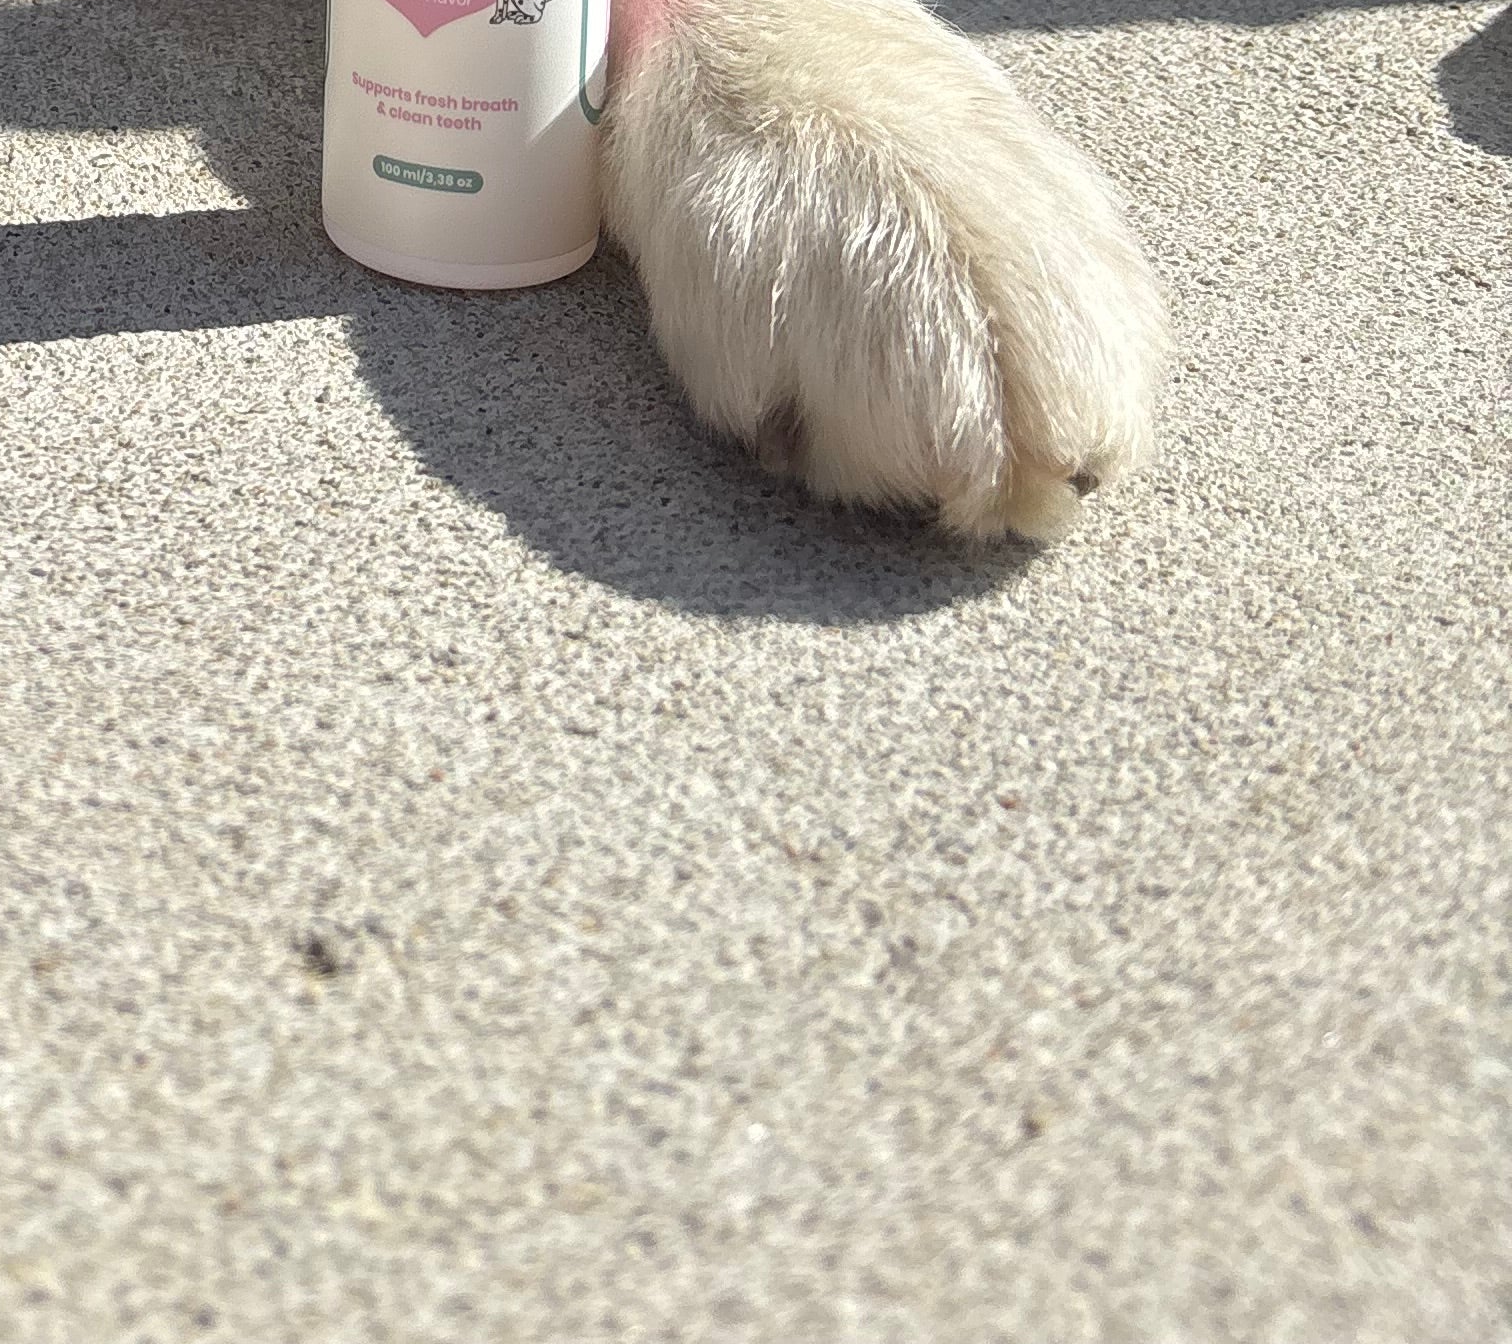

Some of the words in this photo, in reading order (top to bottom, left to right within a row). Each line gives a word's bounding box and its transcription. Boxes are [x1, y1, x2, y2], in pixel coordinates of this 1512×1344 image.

[352, 71, 412, 102] Supports
[415, 90, 458, 110] fresh
[461, 96, 519, 112] breath
[376, 101, 386, 115] &
[389, 106, 433, 126] clean
[436, 114, 482, 131] teeth
[380, 161, 401, 177] 100
[456, 178, 473, 188] oz
